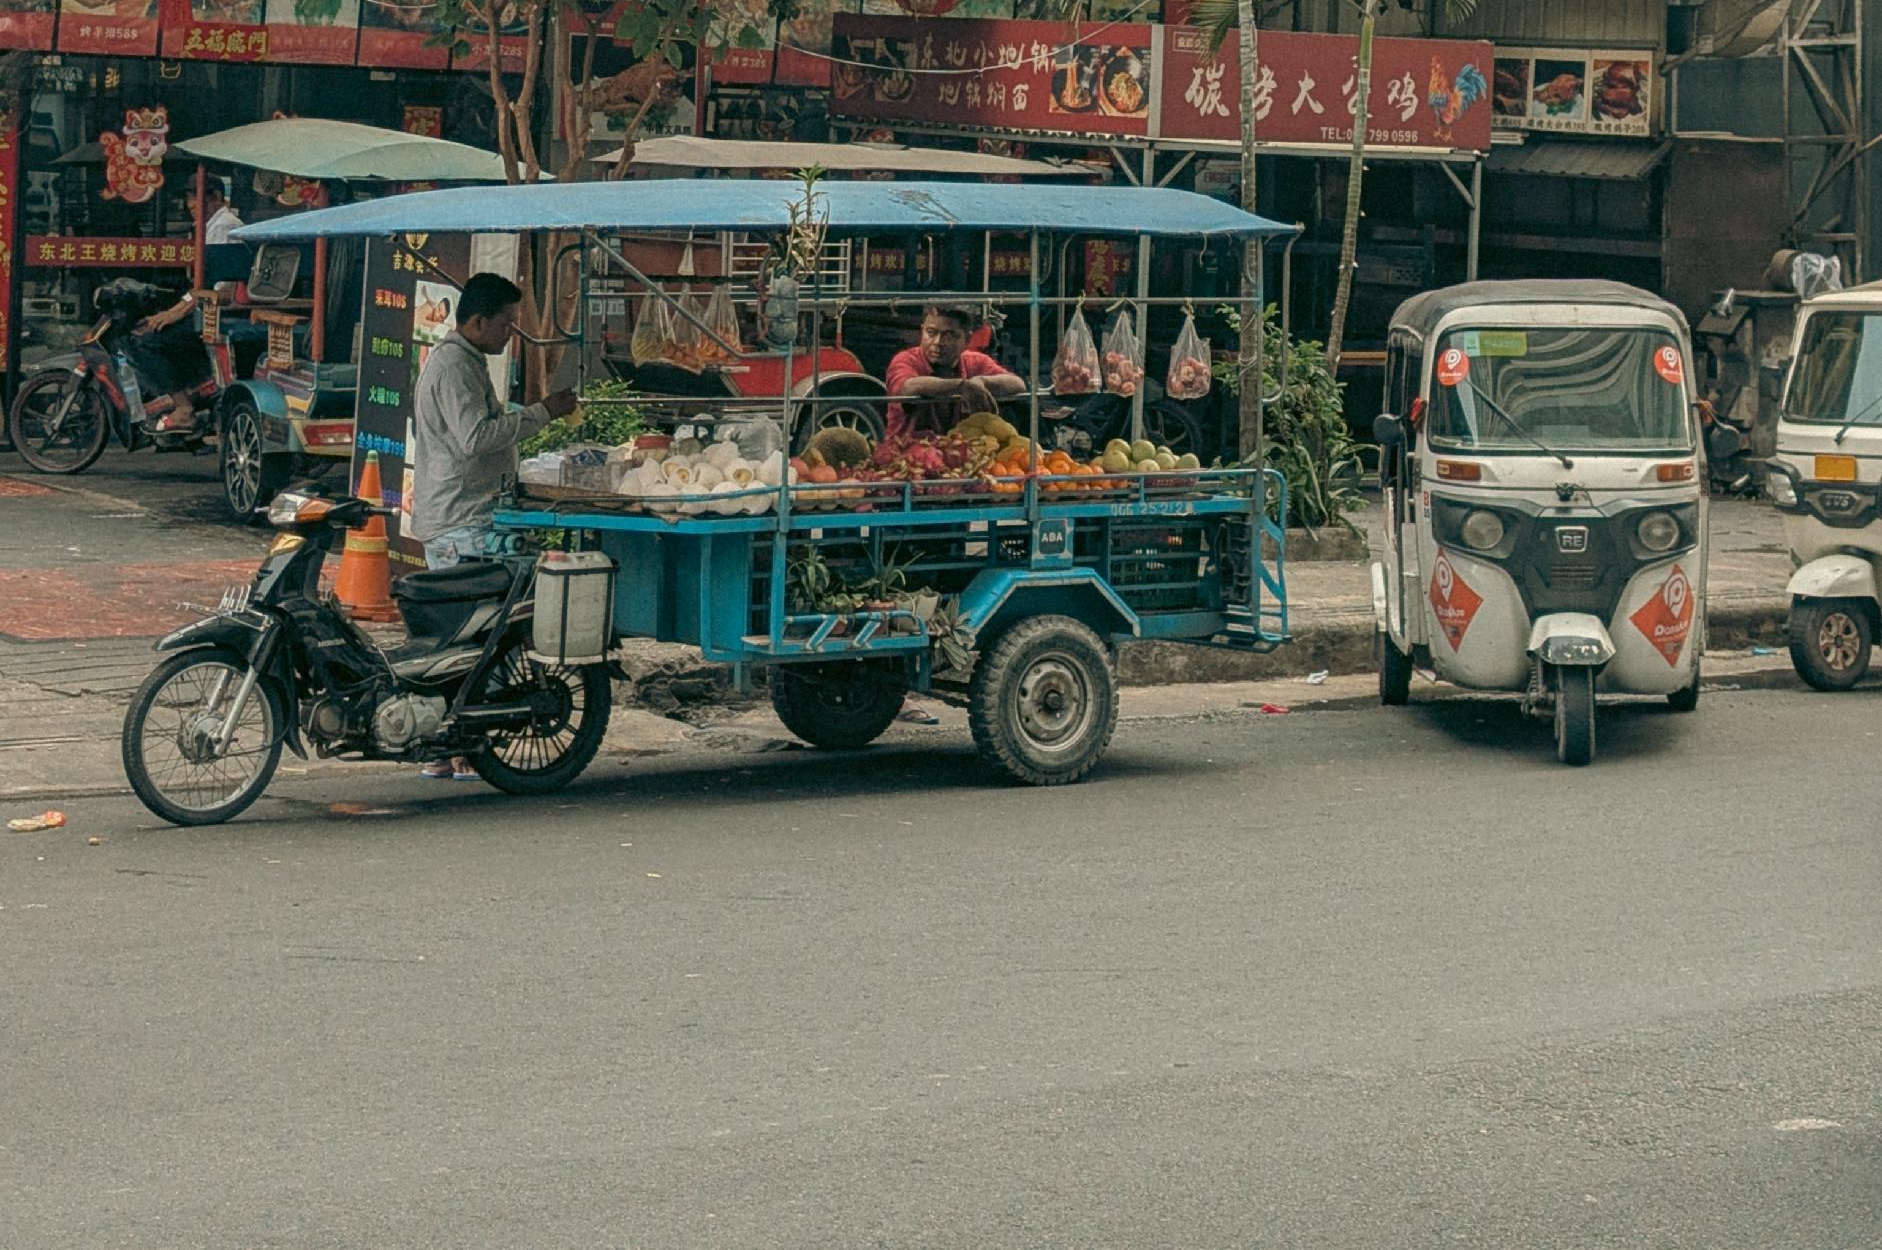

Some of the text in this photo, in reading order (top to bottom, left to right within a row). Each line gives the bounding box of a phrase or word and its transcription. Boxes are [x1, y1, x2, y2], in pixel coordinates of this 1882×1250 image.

[1320, 125, 1419, 144] TEL:0 799 0596
[39, 242, 195, 264] 东北王烧烤欢迎您
[1041, 531, 1063, 543] ABA
[1562, 535, 1583, 547] RE
